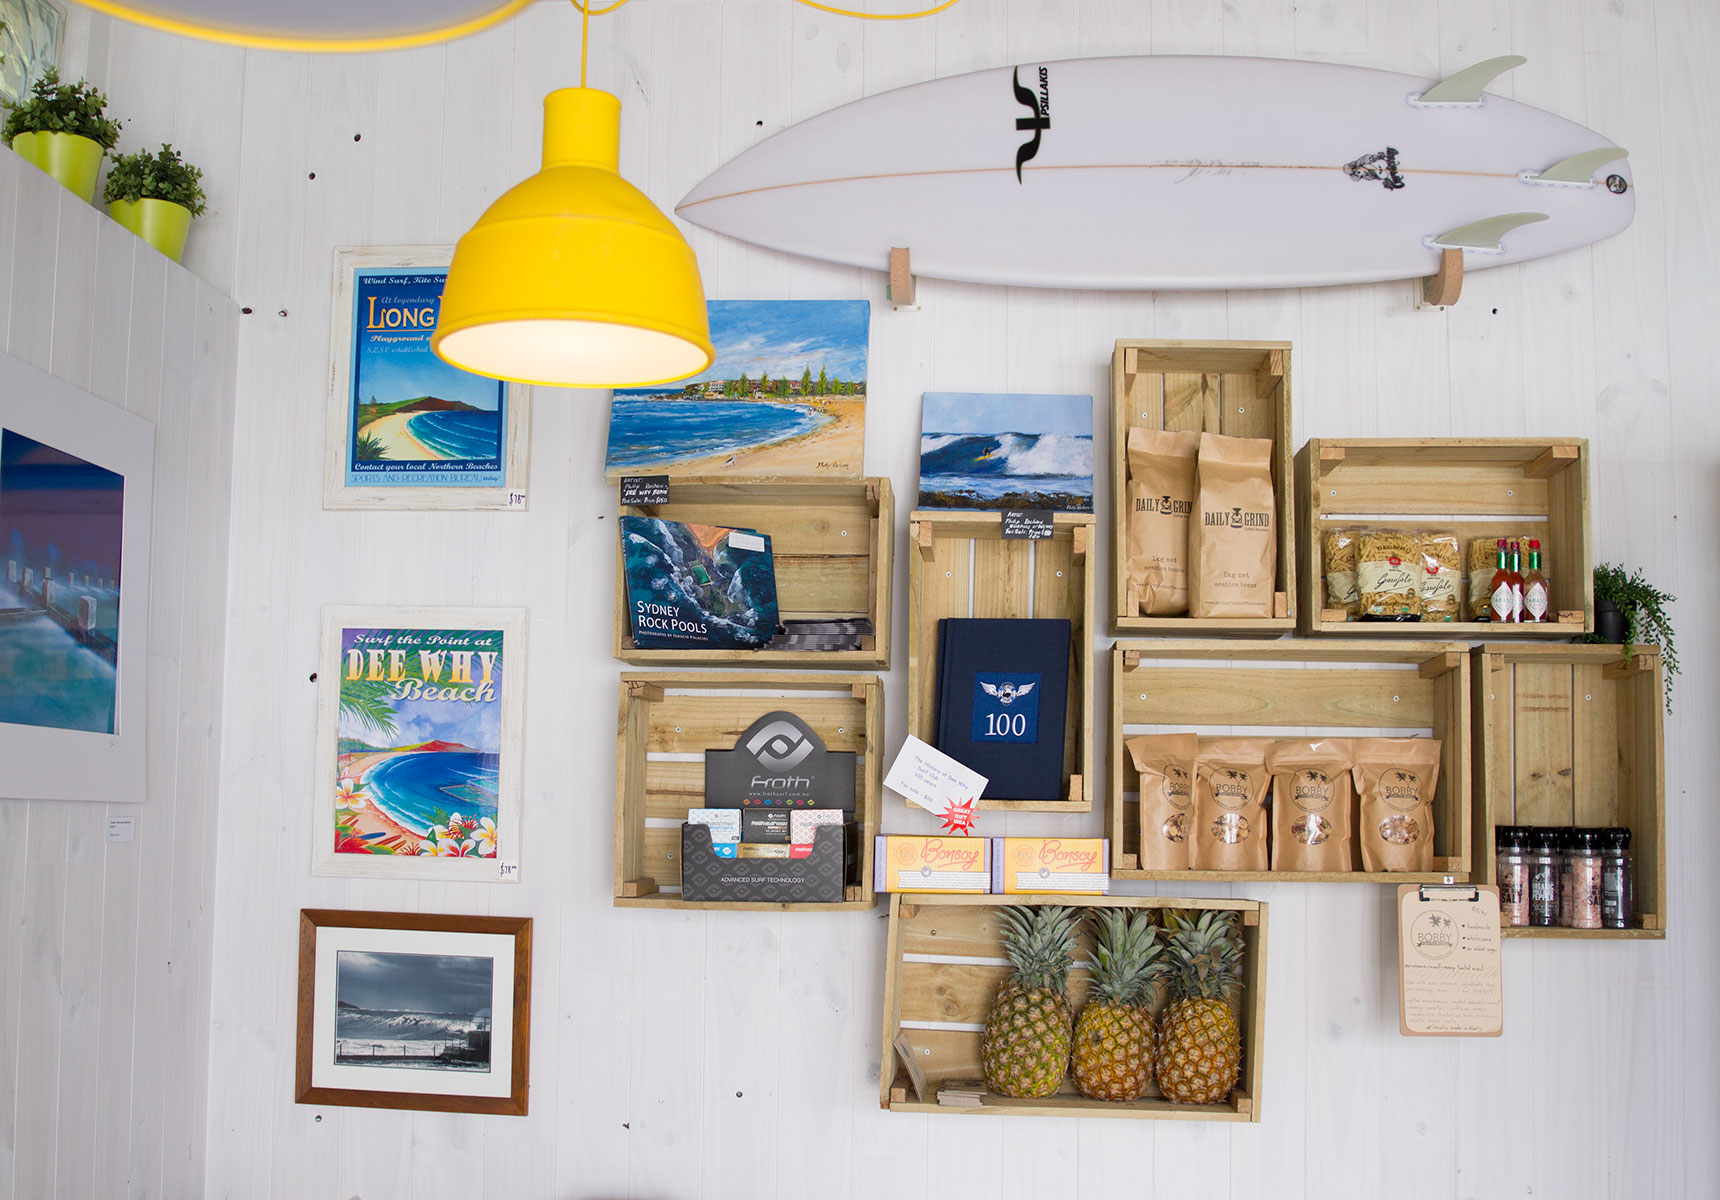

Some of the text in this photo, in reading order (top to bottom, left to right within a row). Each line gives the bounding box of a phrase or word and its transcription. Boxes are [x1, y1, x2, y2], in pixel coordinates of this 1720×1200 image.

[1039, 66, 1049, 116] PSILLAKIS
[394, 296, 434, 304] legendary
[366, 296, 434, 328] LONG
[370, 335, 424, 343] Playground
[386, 464, 404, 472] your
[352, 474, 380, 482] SPORTS
[383, 474, 399, 482] AND
[402, 474, 448, 482] RECREATION
[451, 474, 482, 482] BUREAU
[1136, 498, 1193, 514] DAILY GRIN
[1205, 512, 1269, 527] DAILY GRIND
[637, 600, 679, 617] SYDNEY
[638, 615, 707, 634] ROCK POOLS
[354, 634, 493, 646] Surf the Point at
[346, 648, 498, 684] DEE WHY
[391, 678, 496, 702] Beach
[985, 713, 1026, 736] 100
[1216, 784, 1247, 793] BOBBY
[1296, 786, 1328, 795] BOBBY
[1386, 786, 1418, 795] BOBBY
[921, 838, 979, 870] Bonsoy
[1039, 840, 1097, 872] Bonsoy
[1418, 933, 1451, 942] BOBBY
